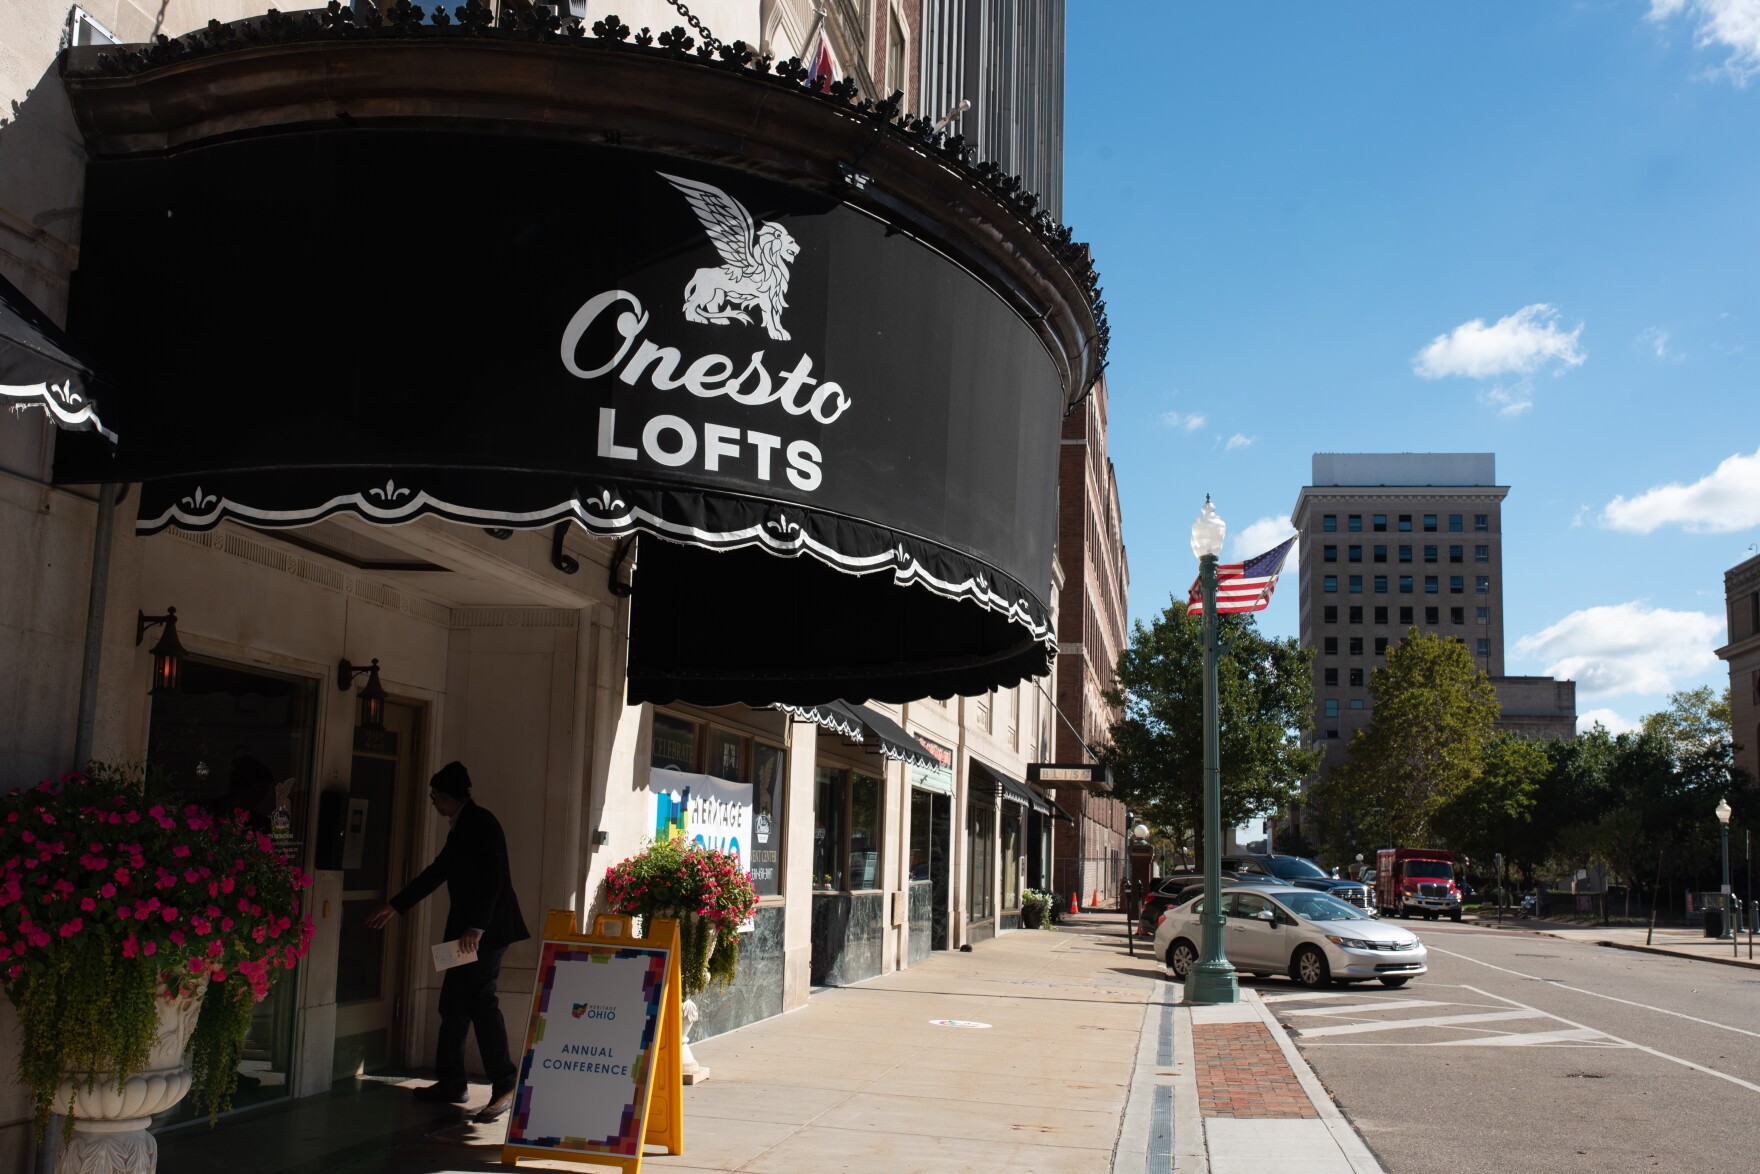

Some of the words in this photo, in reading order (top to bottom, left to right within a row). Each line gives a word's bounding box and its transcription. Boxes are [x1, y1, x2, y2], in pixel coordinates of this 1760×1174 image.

[560, 289, 852, 425] Onesto
[597, 407, 823, 491] LOFTS
[652, 736, 694, 764] CELEBRATE
[1042, 769, 1090, 780] BLISS
[691, 798, 743, 828] HERITAGE
[762, 850, 777, 863] CENTER
[587, 1009, 616, 1021] OHIO
[561, 1043, 614, 1058] ANNUAL
[542, 1058, 628, 1076] CONFERENCE
